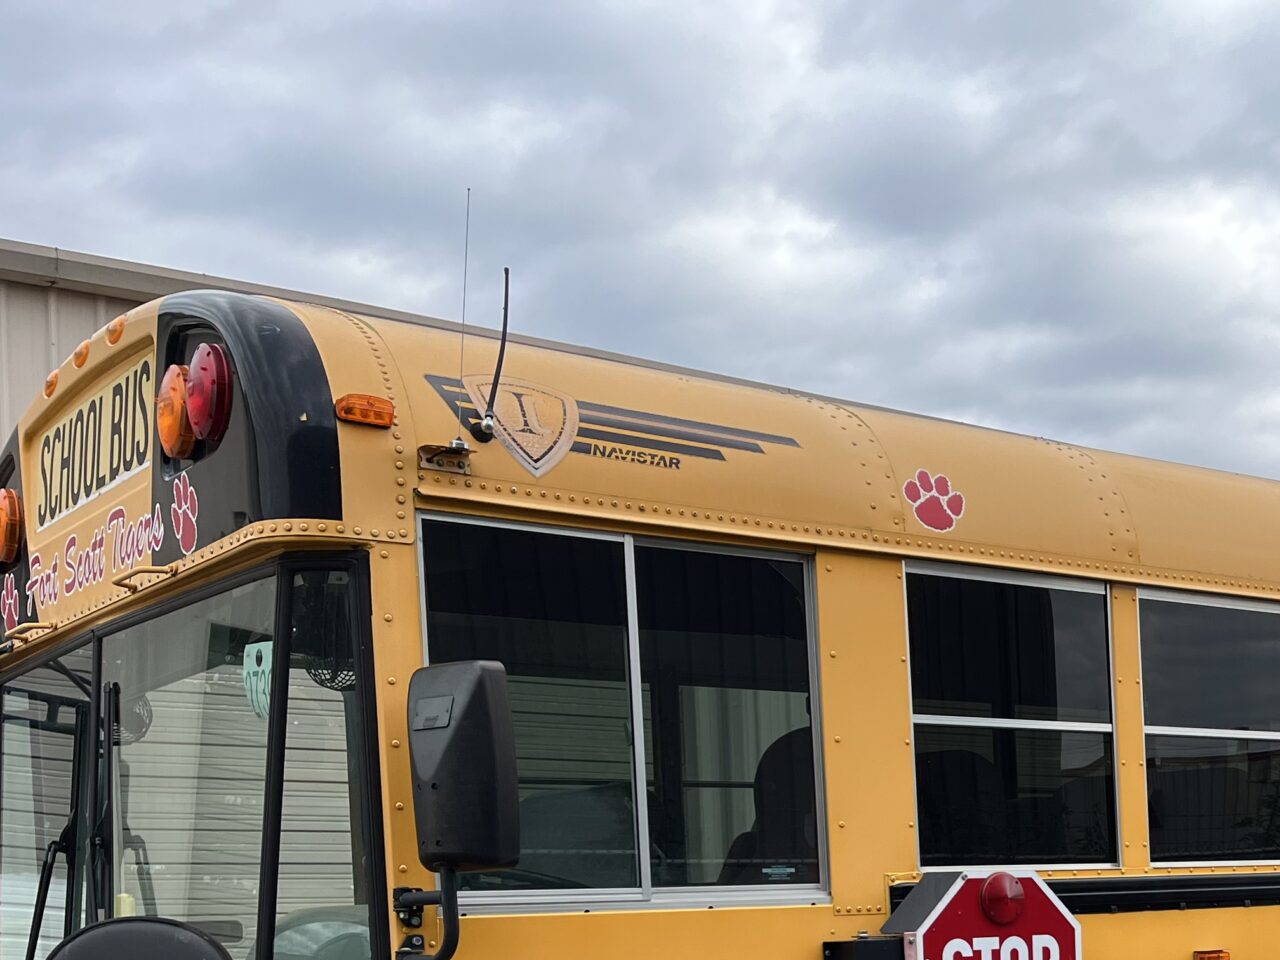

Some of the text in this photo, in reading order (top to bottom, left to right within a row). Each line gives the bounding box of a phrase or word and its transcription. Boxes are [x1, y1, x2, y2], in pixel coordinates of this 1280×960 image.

[38, 361, 150, 528] SCHOOL BUS
[592, 443, 681, 470] NAVISTAR
[26, 503, 164, 617] Fort Scott Tigers
